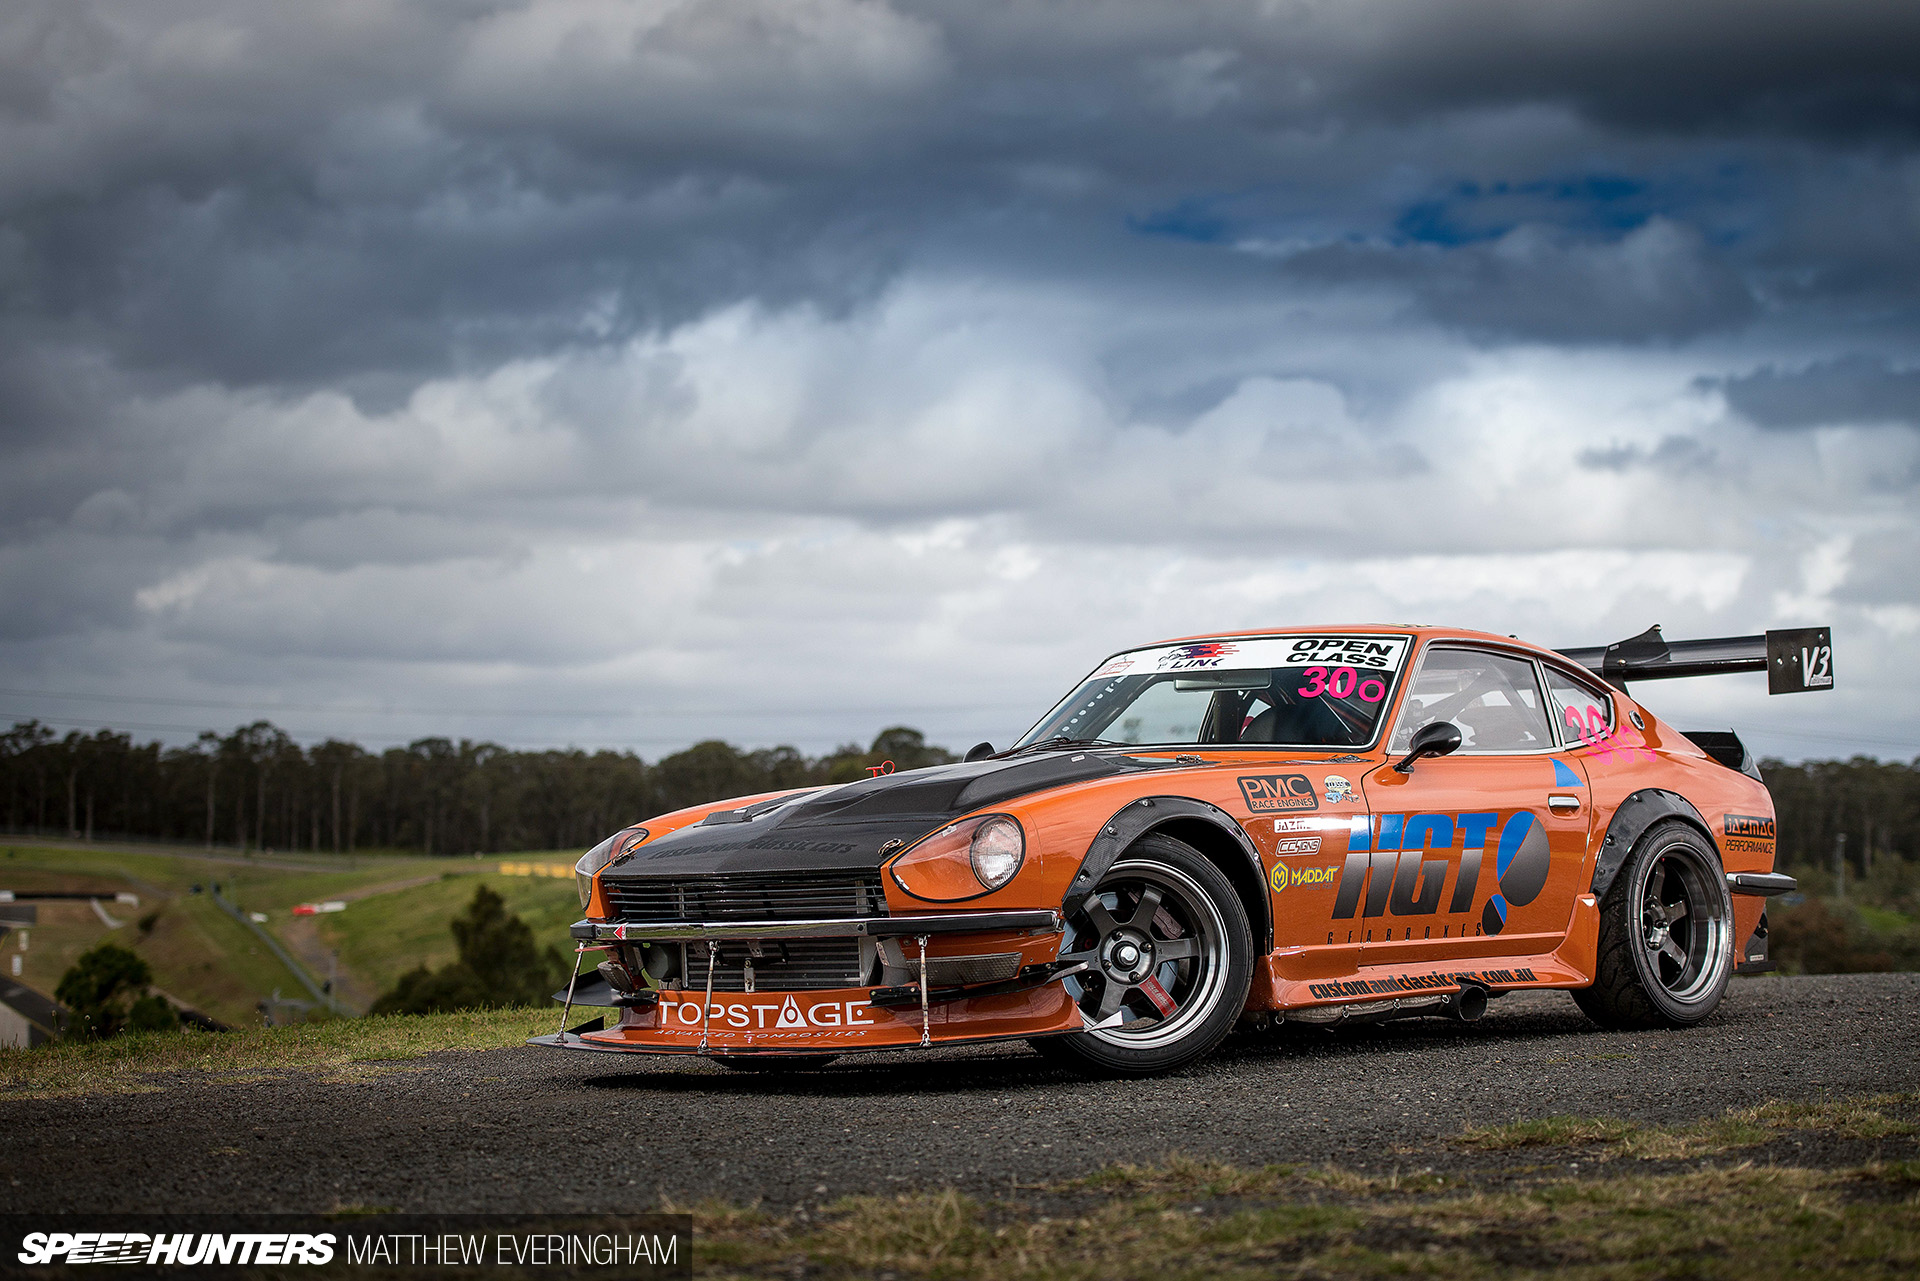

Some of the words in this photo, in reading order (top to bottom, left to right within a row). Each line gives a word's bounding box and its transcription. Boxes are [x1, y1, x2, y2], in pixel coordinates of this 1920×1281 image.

[1292, 640, 1394, 656] OPEN
[1286, 652, 1389, 667] CLASS
[1802, 646, 1831, 687] V3
[1241, 776, 1312, 799] PMC
[1252, 800, 1276, 809] RACE
[1277, 797, 1314, 808] ENGINES
[1725, 839, 1774, 854] PERFORMANCE
[1291, 865, 1340, 886] MADDAT
[1327, 922, 1482, 945] GEARBOXES
[659, 994, 875, 1029] TOPSTAGE
[654, 1029, 736, 1039] ADVANCED
[743, 1029, 868, 1040] COMPOSITES
